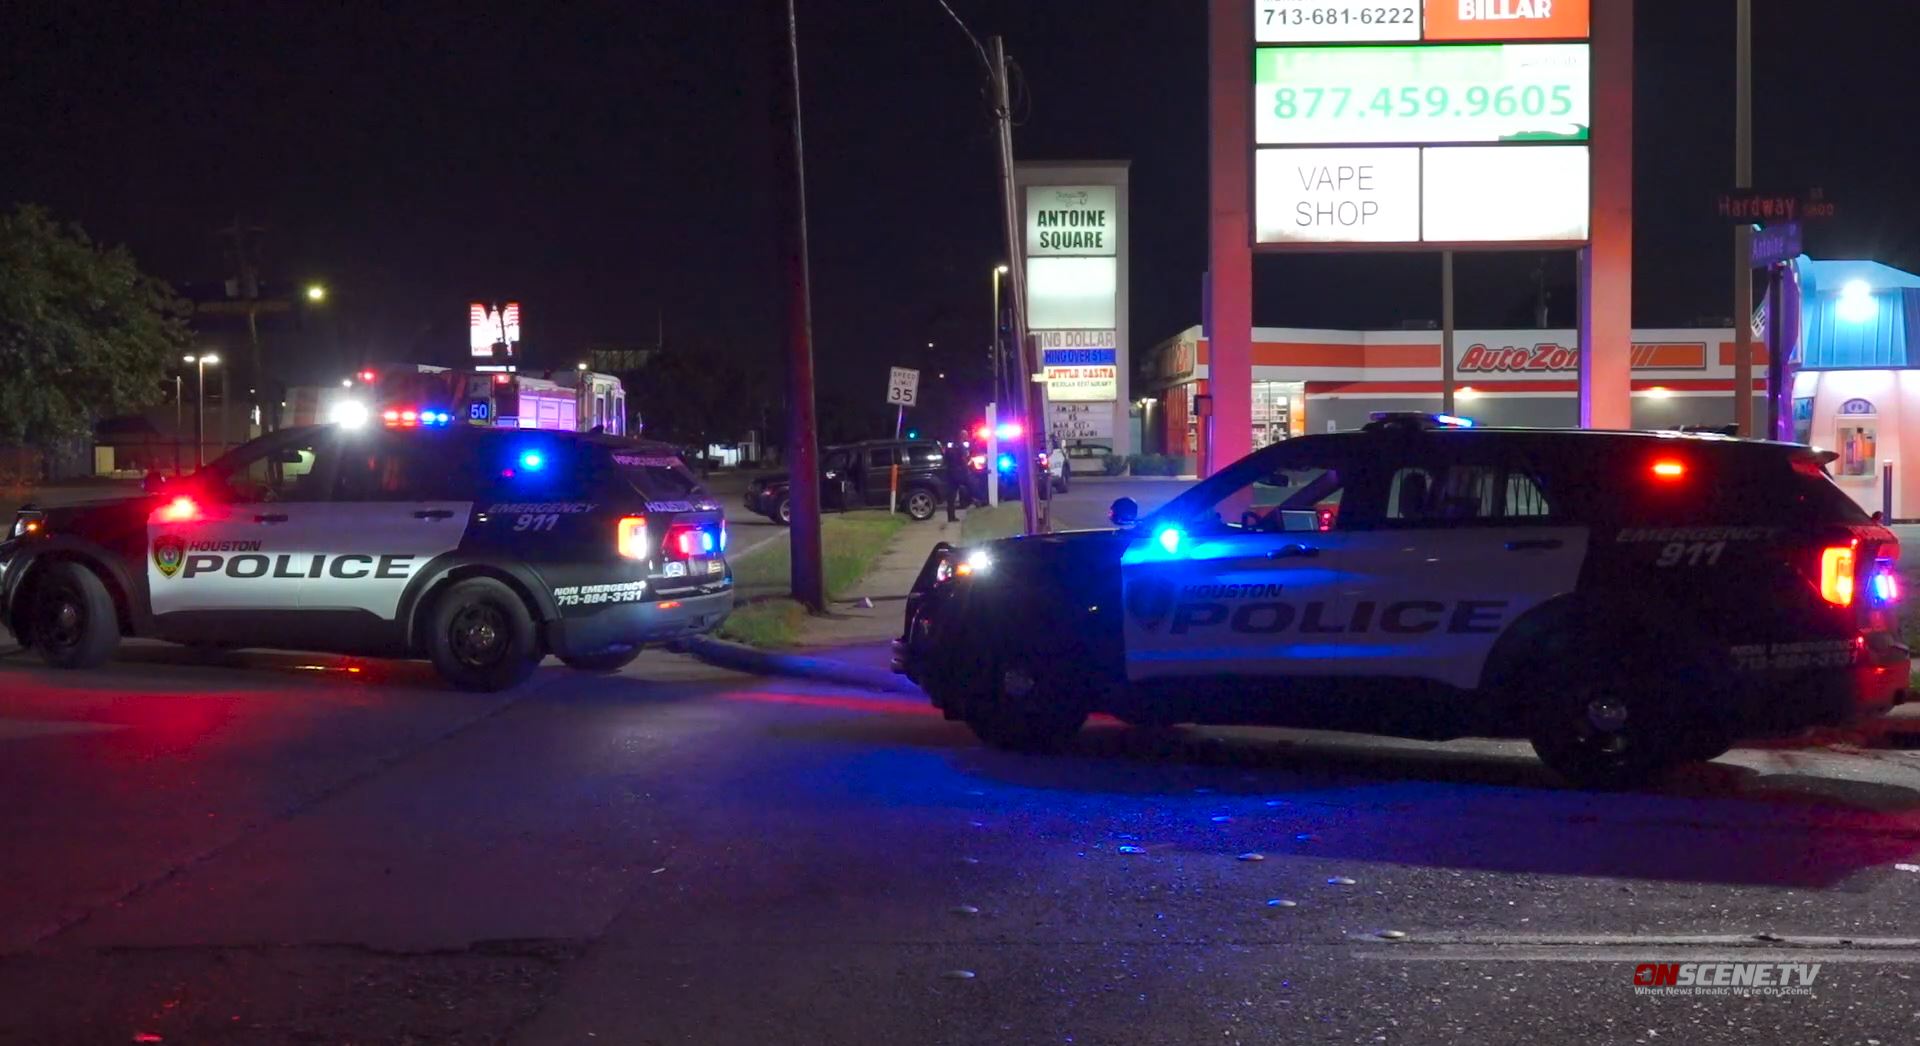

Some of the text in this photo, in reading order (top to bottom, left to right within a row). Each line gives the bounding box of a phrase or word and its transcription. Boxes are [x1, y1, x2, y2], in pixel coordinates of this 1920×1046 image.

[1264, 7, 1414, 24] 713-681-6222
[1458, 0, 1551, 20] BILLAR
[1273, 84, 1572, 119] 877.459.9605
[1298, 165, 1374, 191] VAPE
[1296, 200, 1379, 226] SHOP
[1717, 193, 1796, 220] Hardway
[1037, 209, 1105, 227] ANTOINE
[1039, 230, 1103, 249] SQUARE
[1065, 332, 1115, 347] DOLLAR
[1460, 344, 1578, 371] AutoZon
[893, 371, 916, 380] SPEED
[894, 379, 912, 387] LIMIT
[891, 387, 913, 402] 35
[471, 403, 488, 419] 50
[488, 503, 598, 514] EMERGENCY
[513, 514, 560, 532] 911
[1616, 526, 1773, 543] EMERGENCY
[187, 540, 263, 553] HOUSTON
[1656, 541, 1727, 567] 911
[181, 554, 416, 579] POLICE
[554, 581, 646, 597] NON EMERGENCY
[1183, 583, 1283, 600] HOUSTON
[557, 590, 642, 606] 713-884-3131
[1169, 600, 1508, 635] POLICE
